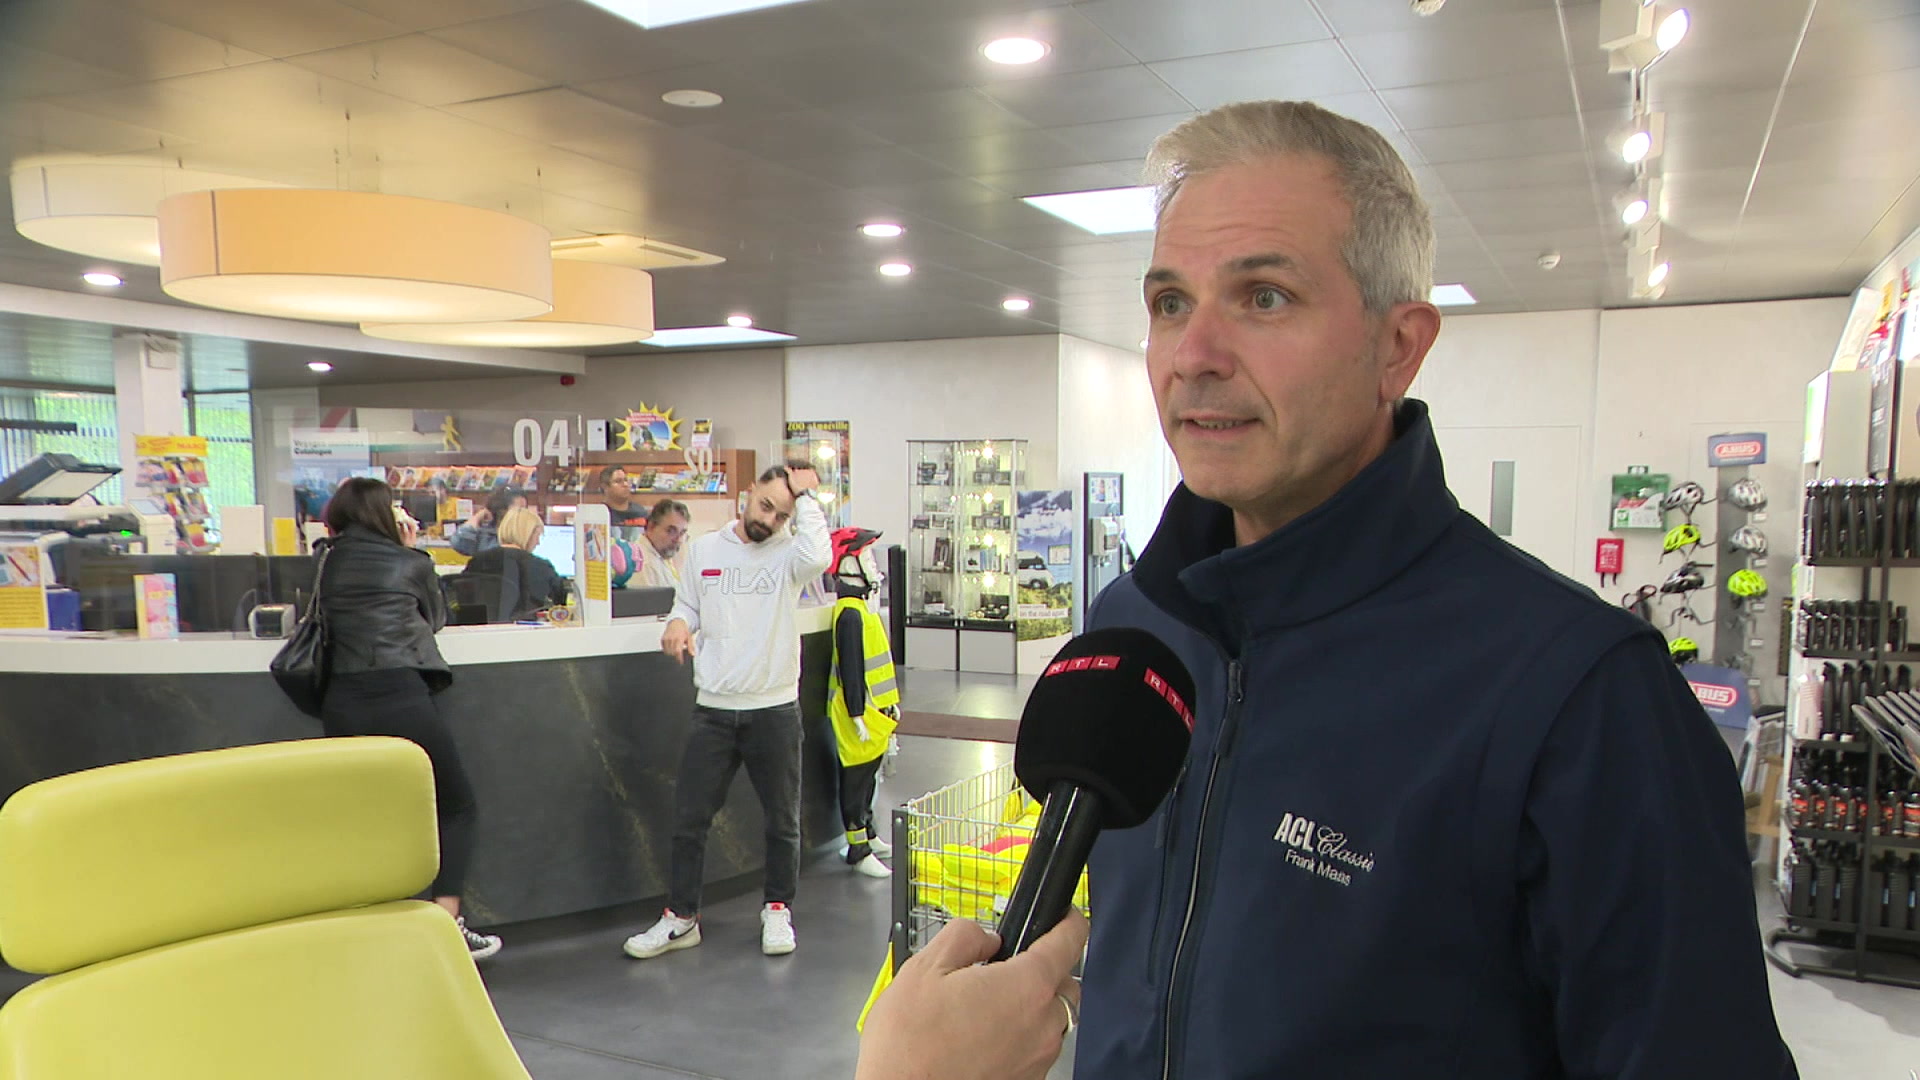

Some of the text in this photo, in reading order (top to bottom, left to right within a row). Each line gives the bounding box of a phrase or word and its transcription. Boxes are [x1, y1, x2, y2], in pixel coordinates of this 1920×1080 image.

[788, 422, 805, 431] ZOO
[513, 418, 572, 467] 04
[1721, 444, 1756, 455] ABUS
[700, 567, 777, 595] FILA
[1050, 658, 1110, 673] RTL
[1150, 674, 1193, 728] RTL
[1697, 687, 1730, 702] BUS
[1273, 812, 1316, 852] ACL
[1284, 848, 1352, 887] Frank Maas
